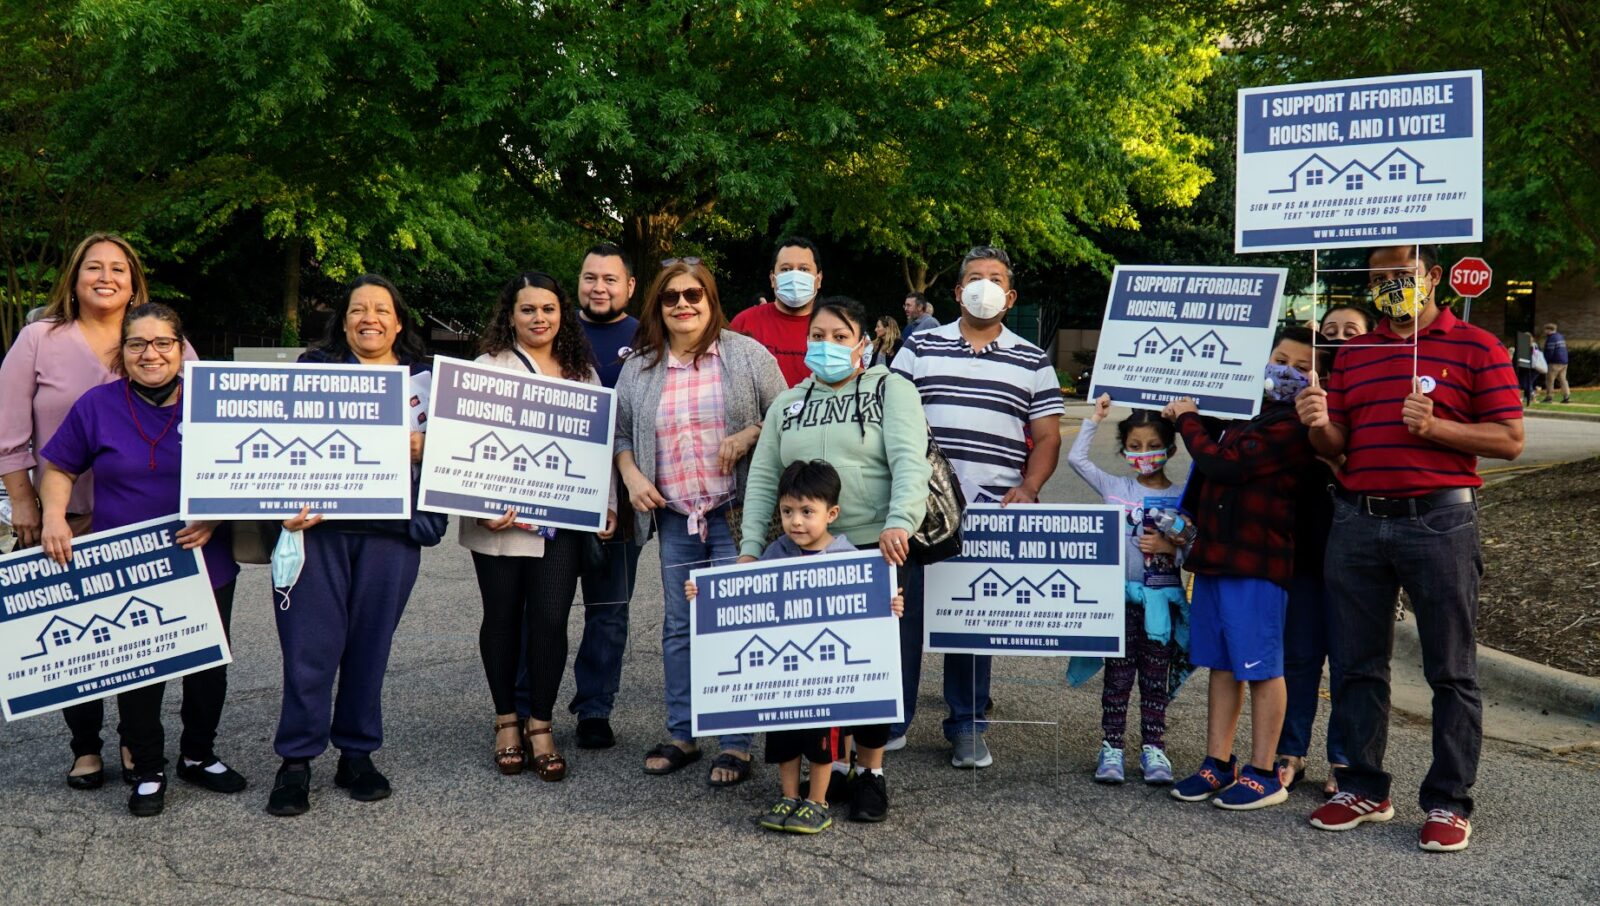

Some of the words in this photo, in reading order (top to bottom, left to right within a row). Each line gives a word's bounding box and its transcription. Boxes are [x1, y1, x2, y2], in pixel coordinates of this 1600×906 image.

[1262, 98, 1268, 118] I
[1272, 92, 1345, 116] SUPPORT
[1349, 84, 1453, 111] AFFORDABLE
[1269, 122, 1344, 145] HOUSING,
[1349, 118, 1383, 139] AND
[1388, 117, 1393, 137] I
[1398, 114, 1445, 136] VOTE!
[1250, 203, 1268, 211] SIGN
[1271, 202, 1282, 210] UP
[1285, 201, 1295, 209] AS
[1312, 197, 1363, 207] AFFORDABLE
[1366, 195, 1403, 204] HOUSING
[1406, 193, 1432, 202] VOTER
[1436, 192, 1466, 201] TODAY!
[1284, 212, 1302, 220] TEXT
[1383, 205, 1427, 215] 635-4770
[1314, 226, 1397, 238] WWW.ONEWAKE.ORG
[1127, 276, 1133, 292] I
[1134, 276, 1186, 293] SUPPORT
[1186, 277, 1264, 295] AFFORDABLE
[1453, 269, 1489, 285] STOP
[1127, 300, 1178, 320] HOUSING,
[1181, 302, 1207, 319] AND
[1208, 303, 1215, 319] I
[1217, 303, 1253, 321] VOTE!
[210, 372, 215, 390] I
[219, 372, 289, 391] SUPPORT
[293, 374, 386, 394] AFFORDABLE
[453, 370, 459, 388] I
[461, 372, 520, 398] SUPPORT
[522, 383, 598, 413] AFFORDABLE
[216, 399, 288, 420] HOUSING,
[293, 400, 324, 418] AND
[329, 401, 334, 419] I
[338, 401, 379, 420] VOTE!
[456, 397, 516, 426] HOUSING,
[519, 408, 546, 429] AND
[548, 413, 554, 430] I
[557, 415, 590, 437] VOTE!
[196, 472, 215, 480] SIGN
[258, 472, 306, 480] AFFORDABLE
[962, 515, 1015, 532] UPPORT
[1018, 515, 1104, 533] AFFORDABLE
[72, 529, 172, 570] AFFORDABLE
[957, 540, 1014, 560] OUSING,
[1019, 541, 1046, 558] AND
[1050, 541, 1055, 559] I
[1059, 542, 1097, 559] VOTE!
[2, 583, 79, 616] HOUSING,
[81, 572, 115, 597] AND
[116, 569, 125, 587] I
[125, 558, 172, 584] VOTE!
[710, 580, 715, 599] I
[718, 573, 780, 598] SUPPORT
[783, 562, 873, 591] AFFORDABLE
[717, 602, 780, 627] HOUSING,
[785, 598, 813, 620] AND
[817, 597, 823, 616] I
[826, 592, 867, 615] VOTE!
[8, 670, 25, 681] SIGN
[29, 667, 38, 675] UP
[42, 663, 51, 672] AS
[55, 660, 64, 668] AN
[68, 647, 114, 665] AFFORDABLE
[118, 638, 151, 652] HOUSING
[155, 631, 178, 643] VOTER
[181, 623, 207, 636] TODAY!
[43, 671, 60, 681] TEXT
[100, 659, 109, 667] TO
[77, 666, 155, 692] WWW.ONEWAKE.ORG
[703, 686, 719, 694] SIGN
[756, 679, 799, 689] AFFORDABLE
[802, 676, 833, 686] HOUSING
[837, 674, 859, 684] VOTER
[863, 672, 889, 681] TODAY!
[732, 694, 747, 702] TEXT
[758, 709, 830, 721] WWW.ONEWAKE.ORG
